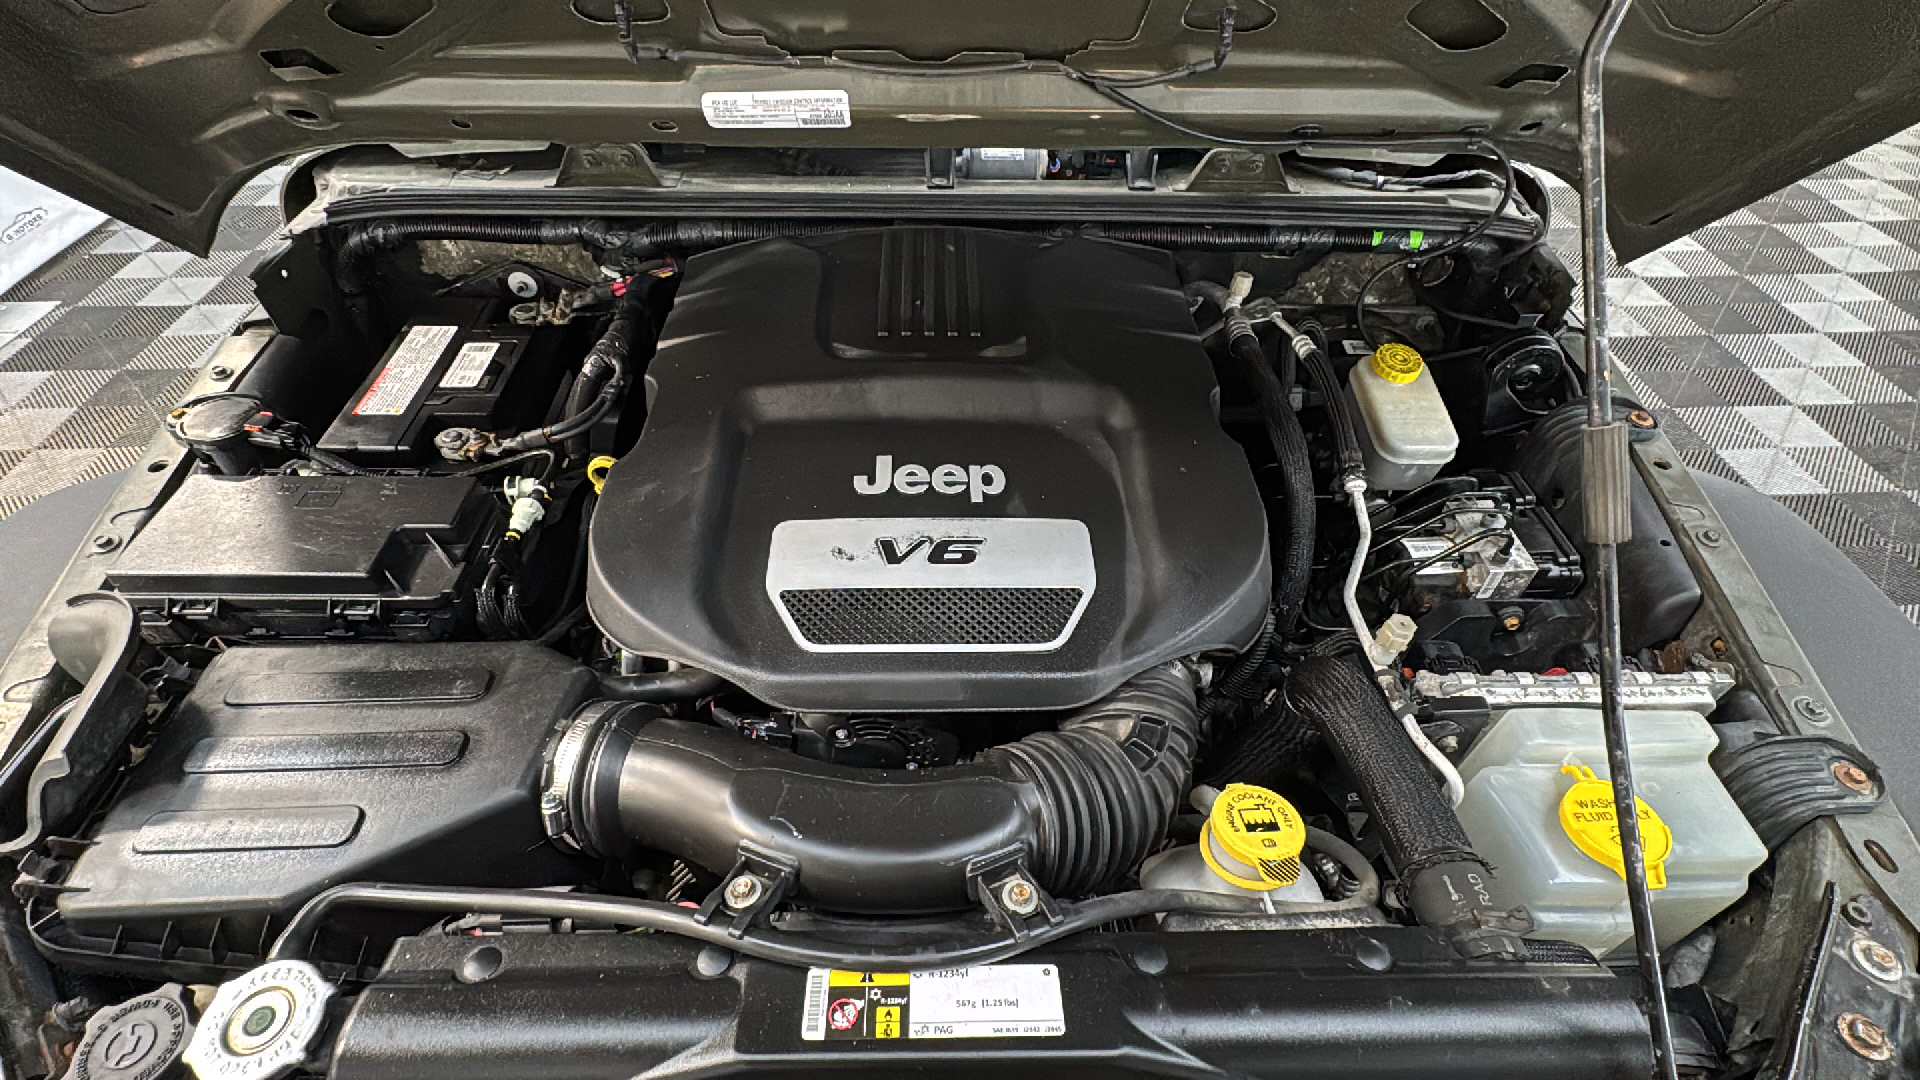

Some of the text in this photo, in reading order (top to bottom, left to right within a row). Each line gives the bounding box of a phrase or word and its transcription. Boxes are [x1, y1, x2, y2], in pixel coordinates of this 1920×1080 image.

[13, 213, 43, 236] MOTORS
[853, 454, 1007, 503] Jeep
[876, 536, 986, 565] V6
[1231, 792, 1277, 805] COOLANT
[1277, 806, 1295, 831] ONLY
[1576, 797, 1616, 809] WASH
[1573, 811, 1614, 822] FLUID
[934, 1025, 953, 1034] PAG
